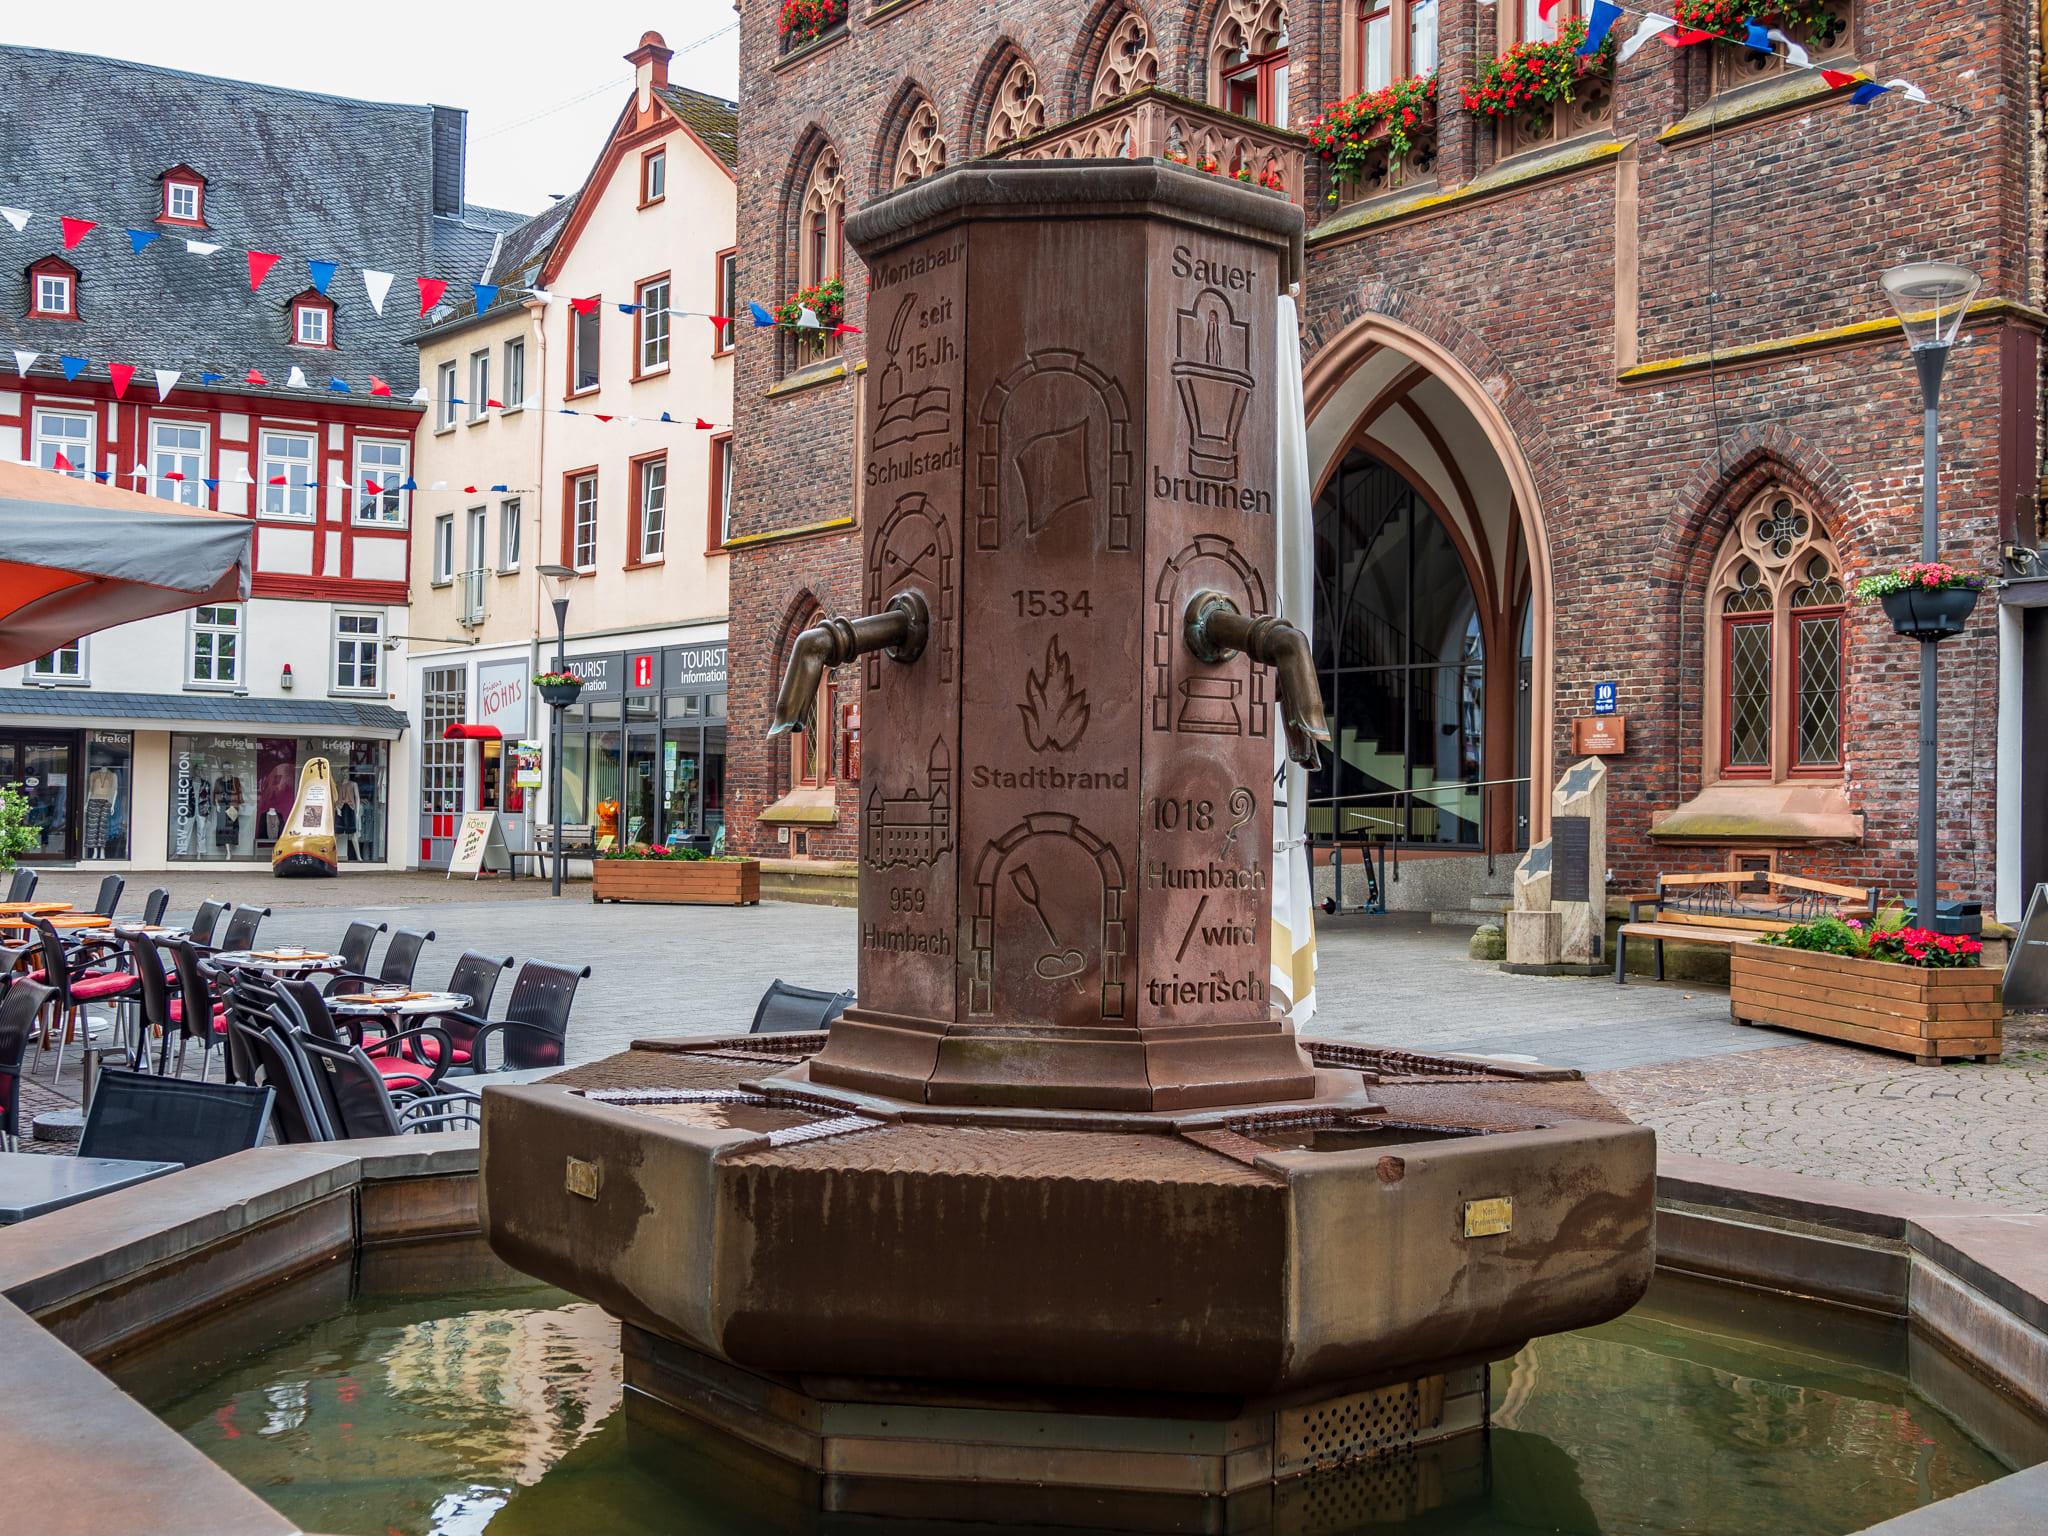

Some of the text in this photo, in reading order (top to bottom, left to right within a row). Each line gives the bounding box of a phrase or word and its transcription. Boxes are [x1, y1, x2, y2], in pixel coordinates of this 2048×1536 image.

[871, 243, 965, 292] Montabaur
[1171, 245, 1256, 294] Sauer
[920, 296, 952, 329] seit
[866, 442, 961, 487] Schulstadt
[1153, 465, 1272, 516] brunnen
[1011, 589, 1094, 619] 1534
[568, 660, 608, 679] TOURIST
[681, 648, 728, 670] TOURIST
[681, 669, 727, 685] Information
[1598, 685, 1612, 699] 10
[95, 733, 131, 744] krekel
[971, 764, 1129, 790] Stadtbrand
[176, 752, 190, 855] NEW COLLECTION
[1150, 797, 1215, 832] 1018
[1148, 862, 1266, 890] Humbach
[890, 887, 925, 913] 959
[863, 923, 950, 956] Humbach
[1202, 918, 1256, 946] wird
[1146, 971, 1264, 1006] trierisch
